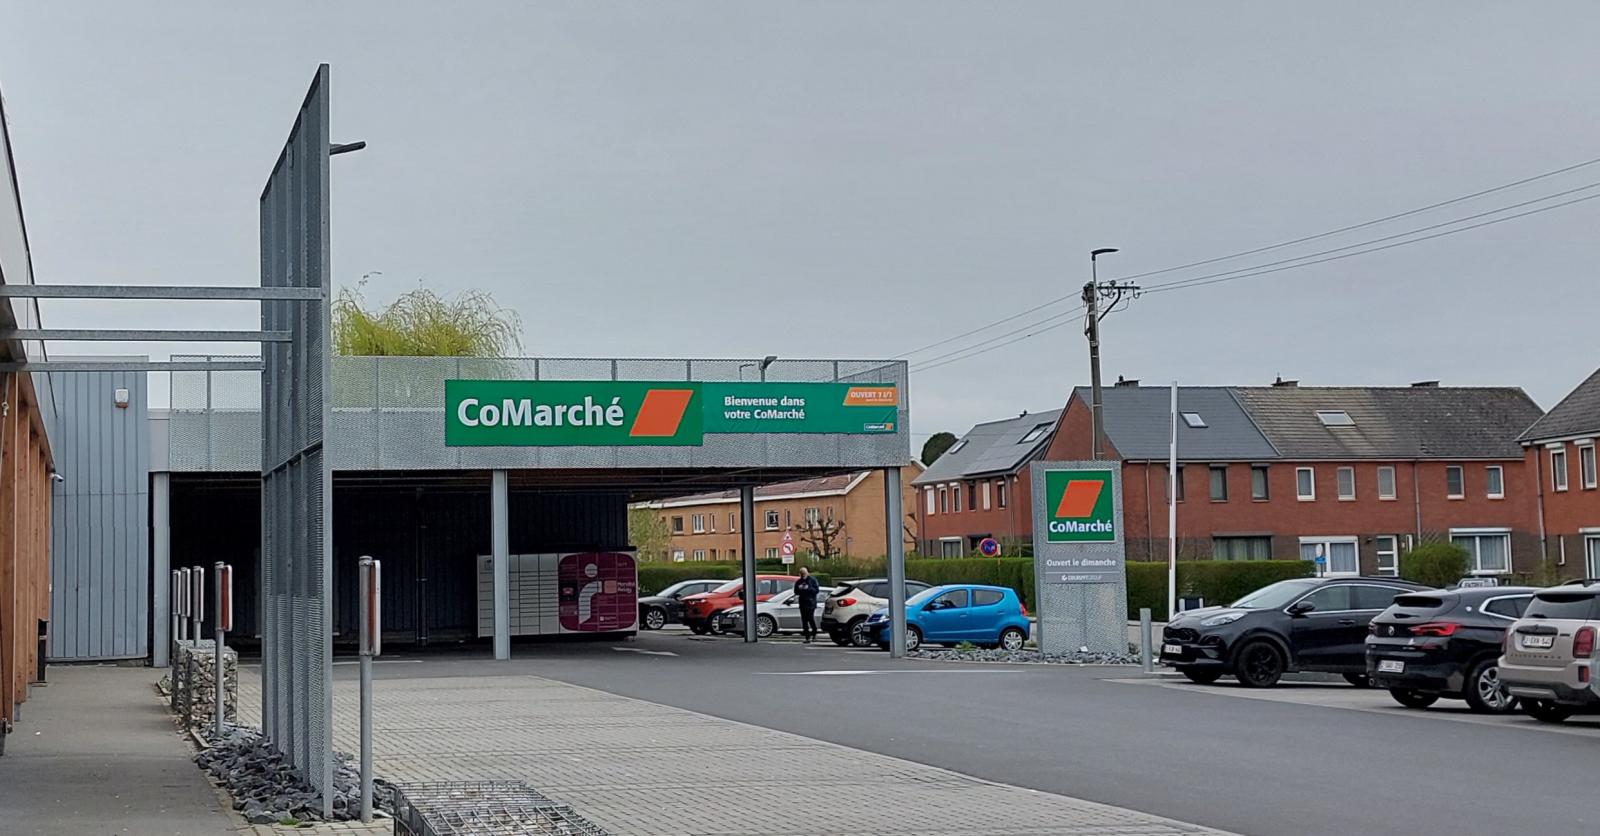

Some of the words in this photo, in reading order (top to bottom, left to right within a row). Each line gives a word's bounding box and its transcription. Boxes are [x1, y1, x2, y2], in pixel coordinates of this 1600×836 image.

[724, 395, 778, 406] Bienvenue
[780, 395, 805, 406] dans
[457, 396, 624, 427] CoMarché
[724, 409, 751, 419] votre
[753, 408, 805, 419] CoMarché
[1049, 519, 1113, 533] CoMarché
[1046, 559, 1071, 567] Ouvert
[1072, 558, 1080, 567] le
[1081, 558, 1116, 567] dimanche
